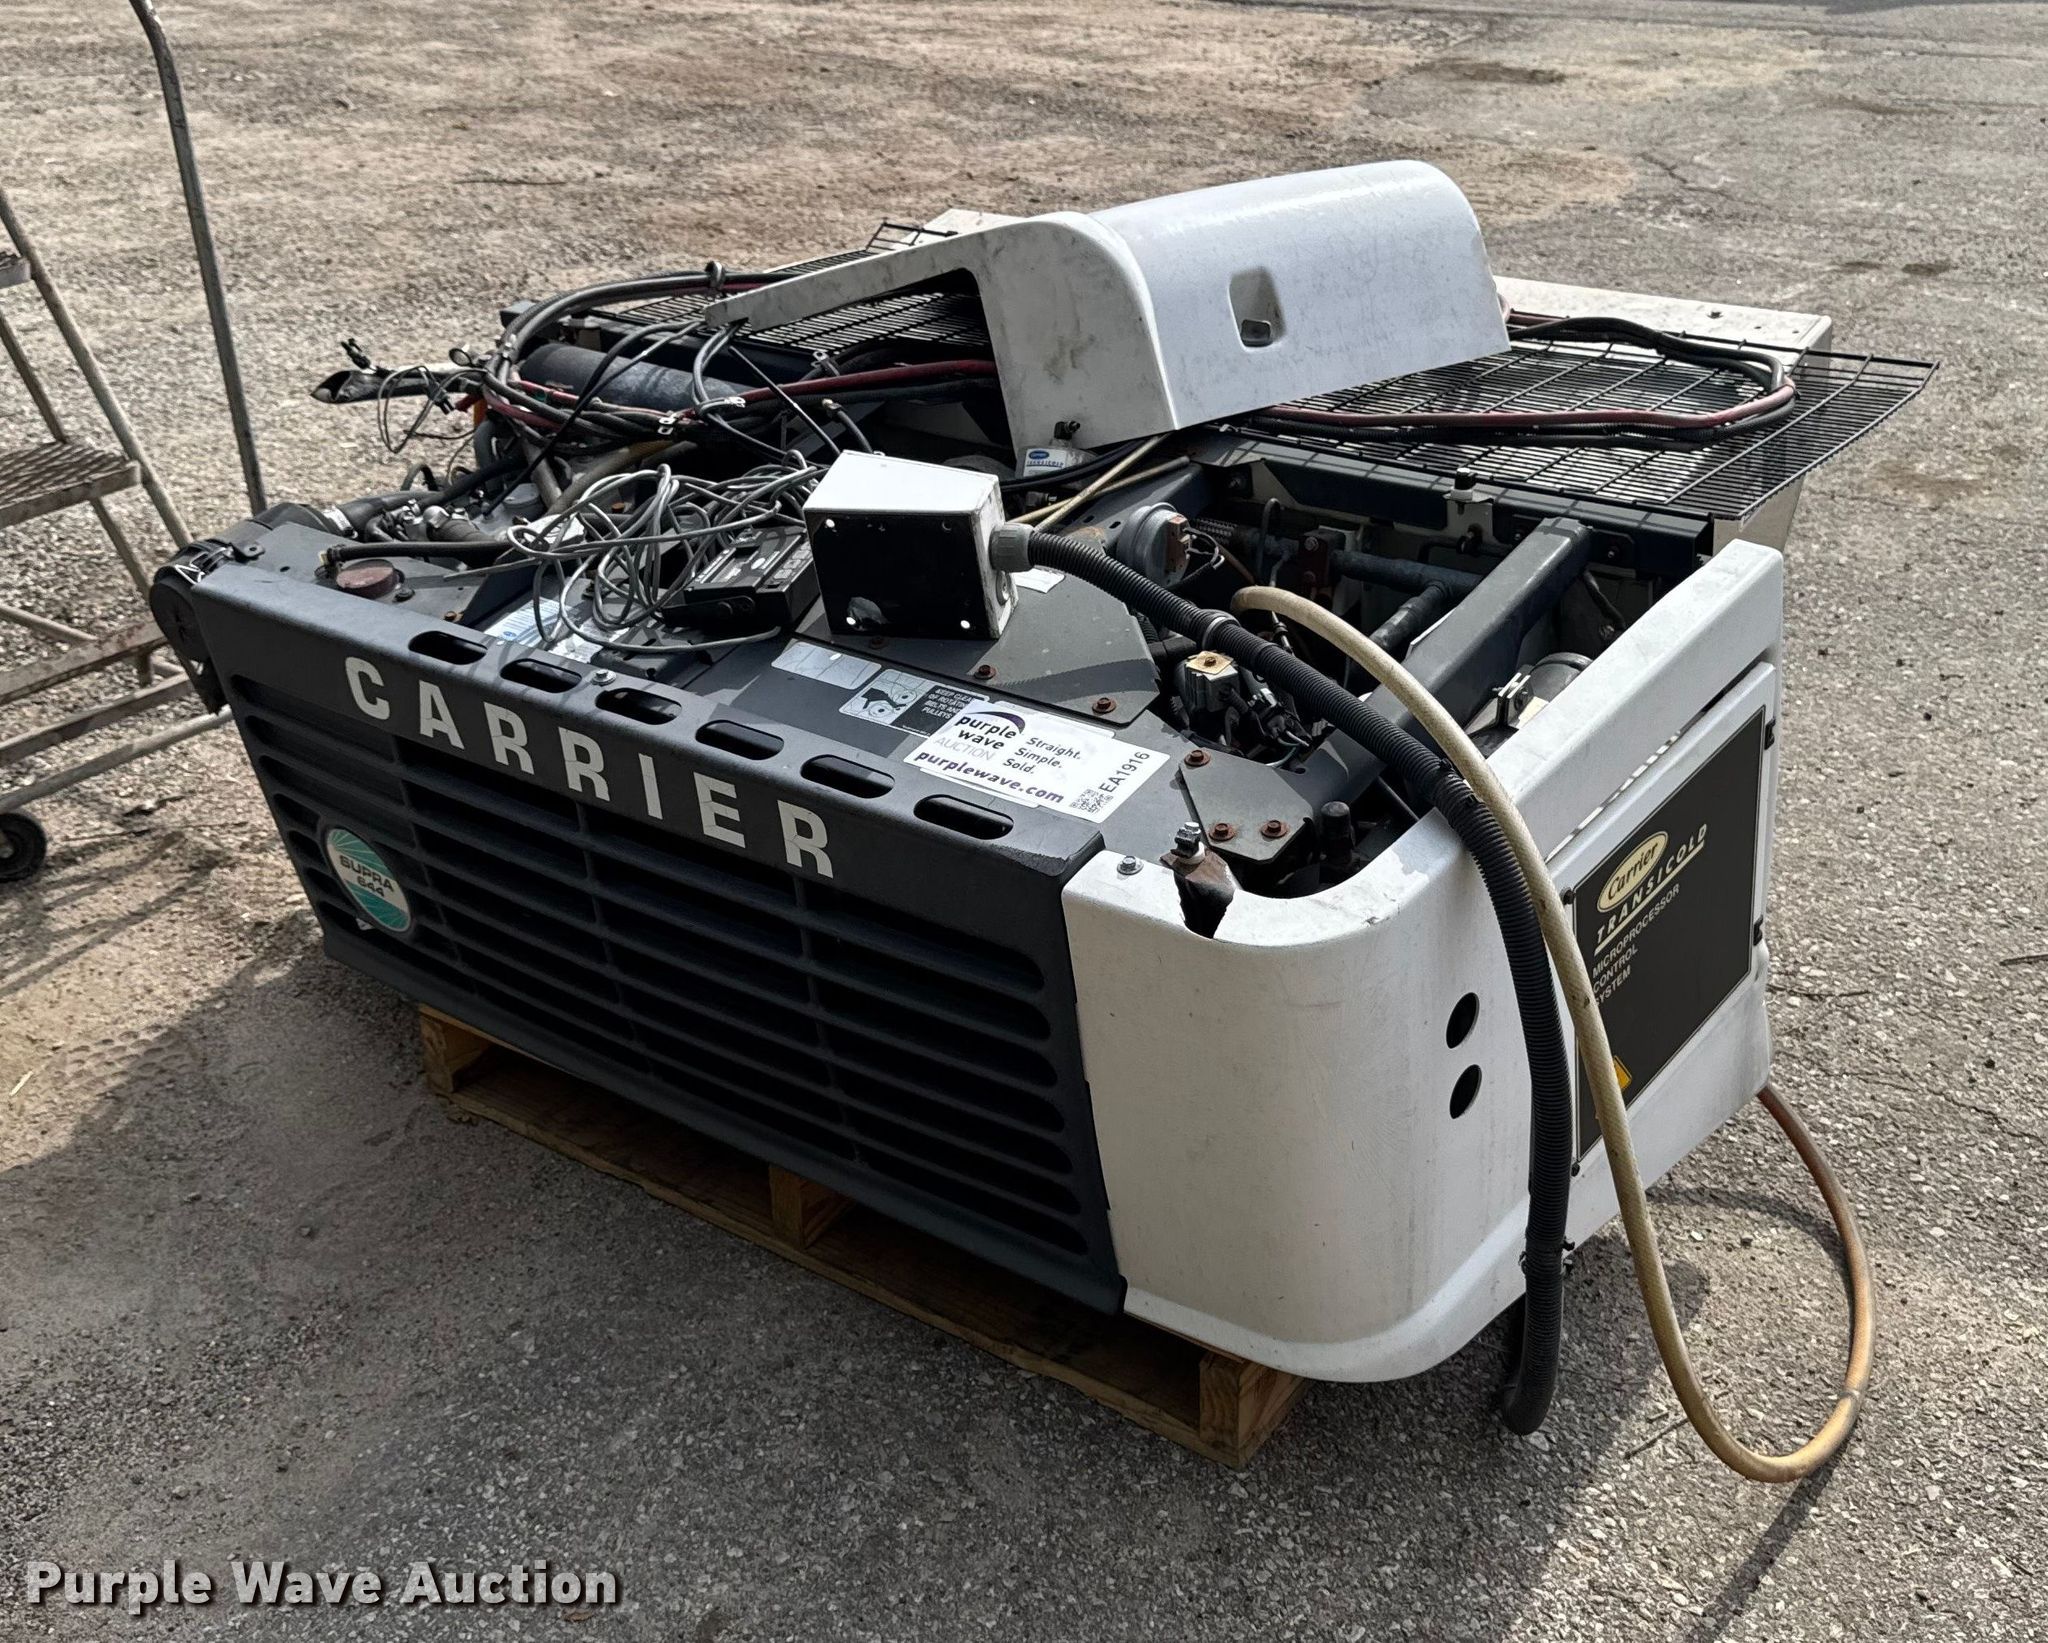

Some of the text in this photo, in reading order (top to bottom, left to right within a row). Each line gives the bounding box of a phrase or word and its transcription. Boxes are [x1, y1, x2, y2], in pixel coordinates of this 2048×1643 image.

[924, 699, 948, 710] BELTS
[935, 688, 973, 703] KEEP CLEA
[921, 706, 953, 720] PULLEYS
[954, 716, 1017, 739] purple
[958, 728, 1005, 750] wave
[933, 737, 996, 761] AUCTION
[1014, 747, 1063, 769] Simple.
[1026, 737, 1082, 760] Straight.
[345, 657, 834, 879] CARRIER
[914, 751, 1065, 804] purplewave.com
[1002, 758, 1035, 774] Sold.
[1098, 751, 1150, 793] EA1916
[339, 854, 395, 893] SUPRA
[1608, 842, 1659, 901] Carrier
[356, 875, 385, 898] 644
[1597, 823, 1708, 944] TRANSICOLD
[1593, 883, 1681, 979] MICROPROCESSOR
[1593, 943, 1639, 994] CONTROL
